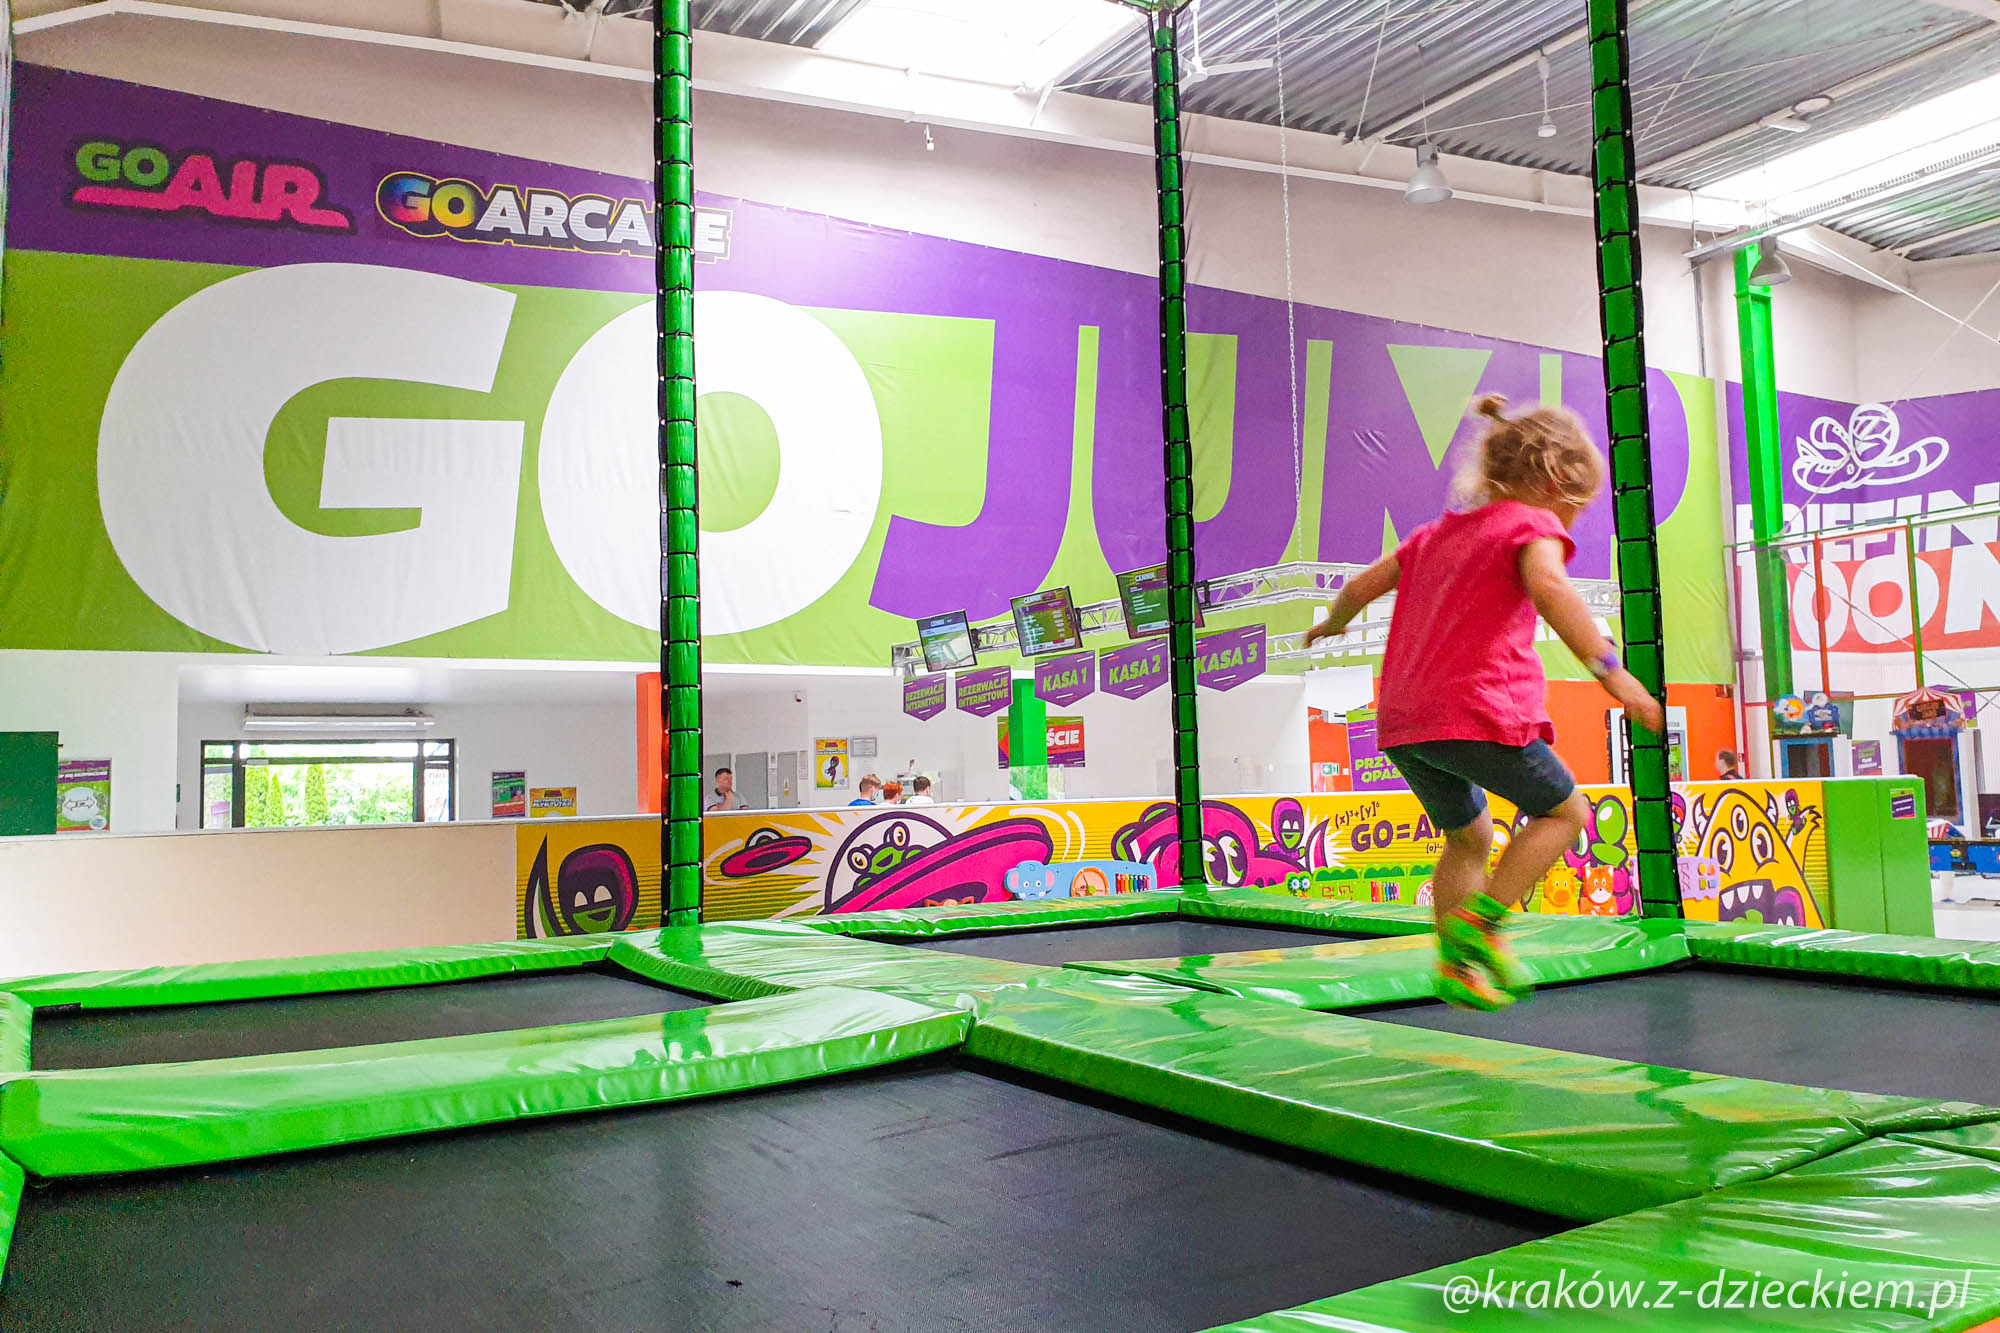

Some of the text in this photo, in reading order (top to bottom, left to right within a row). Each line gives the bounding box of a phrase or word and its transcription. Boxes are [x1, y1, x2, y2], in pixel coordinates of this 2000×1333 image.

[388, 175, 730, 254] GOARCAE
[1109, 655, 1161, 685] KASA 2
[1196, 642, 1258, 675] KASA 3
[1042, 667, 1088, 692] KASA 1
